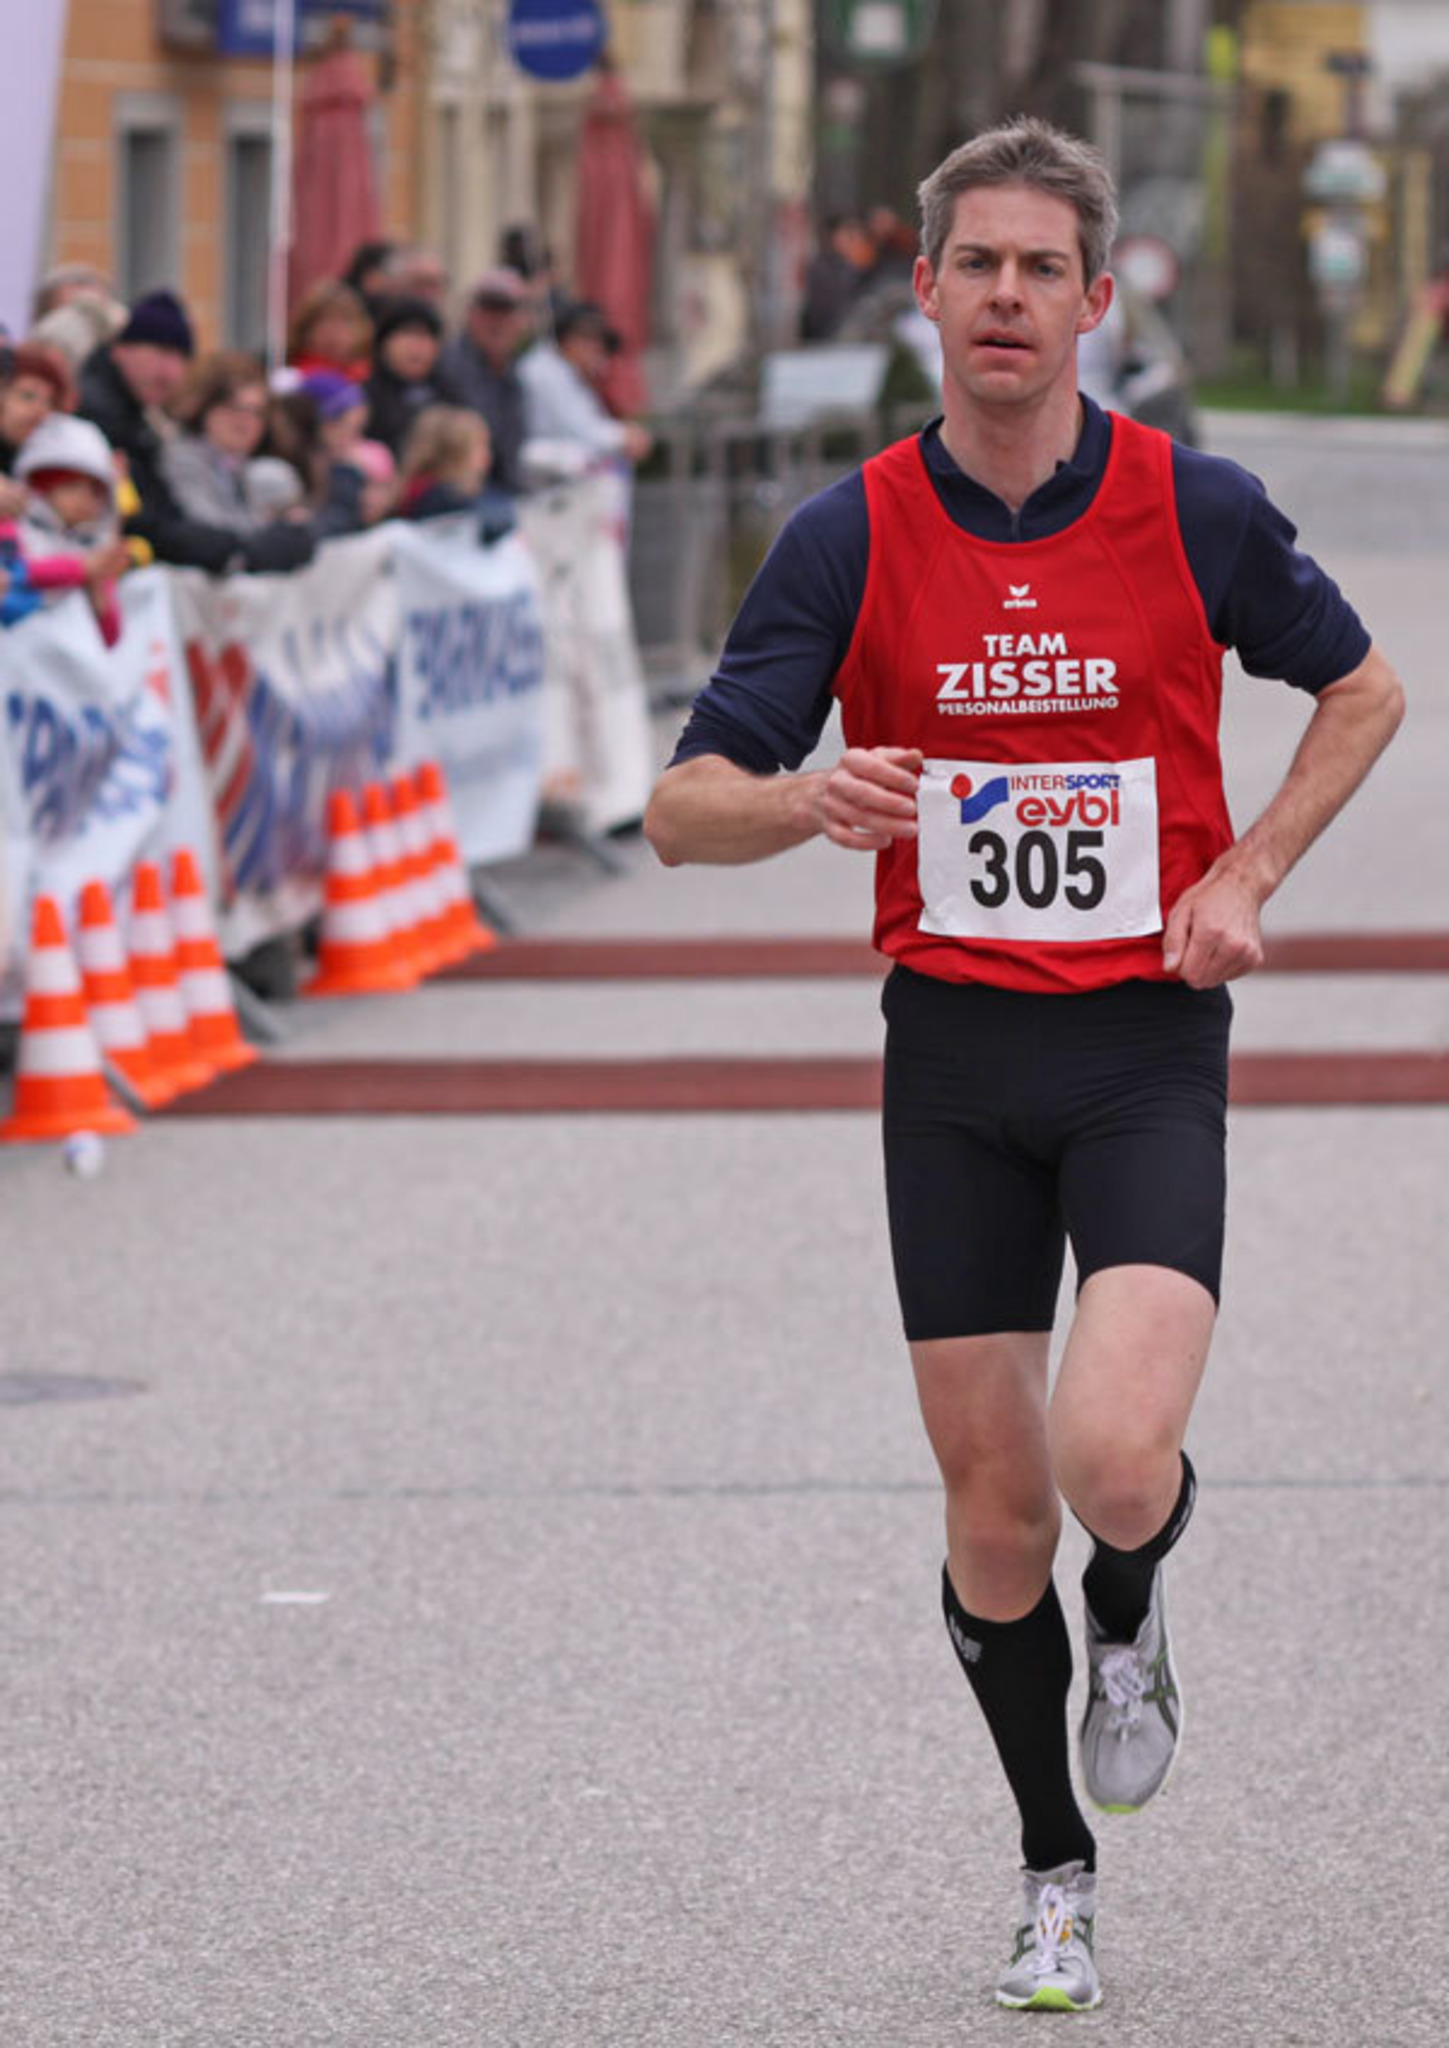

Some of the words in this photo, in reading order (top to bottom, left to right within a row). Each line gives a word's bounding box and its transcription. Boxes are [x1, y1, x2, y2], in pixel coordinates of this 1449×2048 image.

[983, 633, 1067, 656] TEAM
[936, 659, 1119, 700] ZISSER
[938, 697, 1119, 715] PERSONALBEISTELLUNG
[1011, 774, 1121, 790] INTERSPORT
[1016, 791, 1120, 827] eybl
[968, 830, 1107, 911] 305
